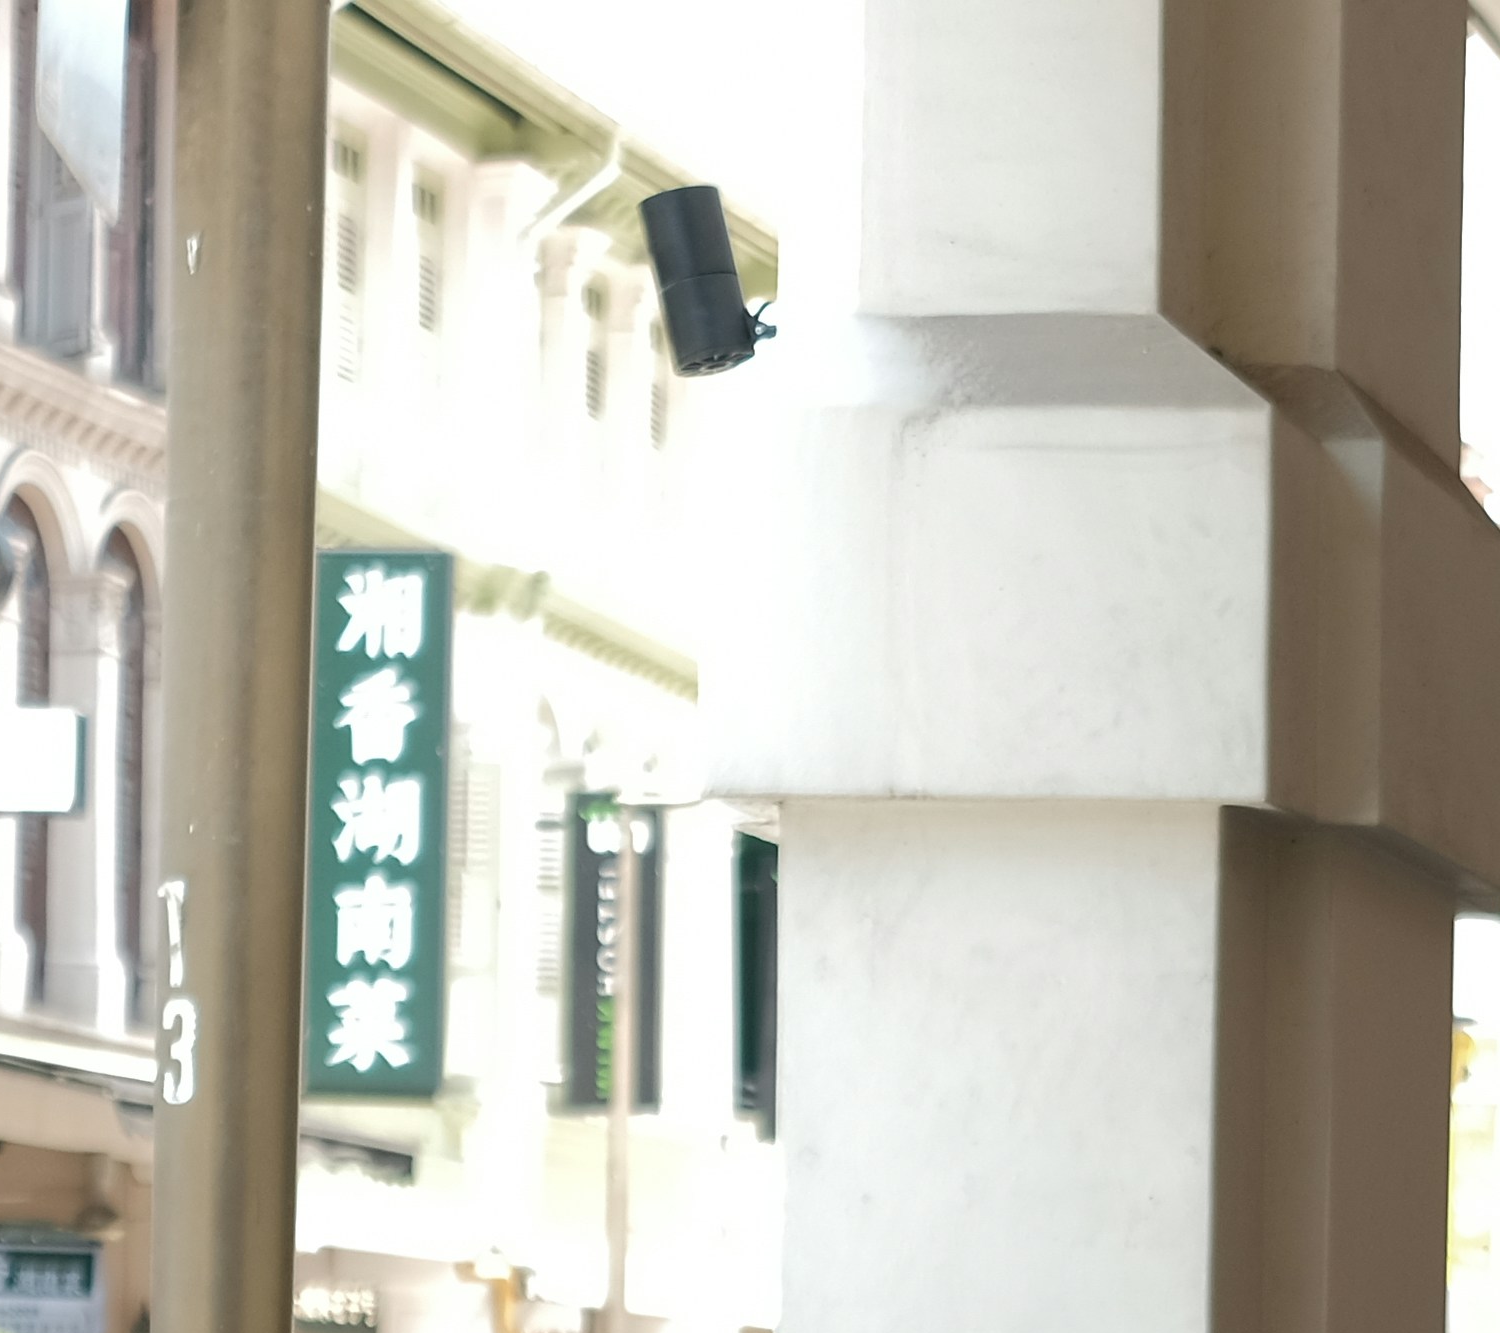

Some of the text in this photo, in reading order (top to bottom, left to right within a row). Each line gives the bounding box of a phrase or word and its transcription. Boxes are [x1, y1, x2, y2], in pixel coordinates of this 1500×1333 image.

[324, 568, 427, 1072] 湘香湖南菜
